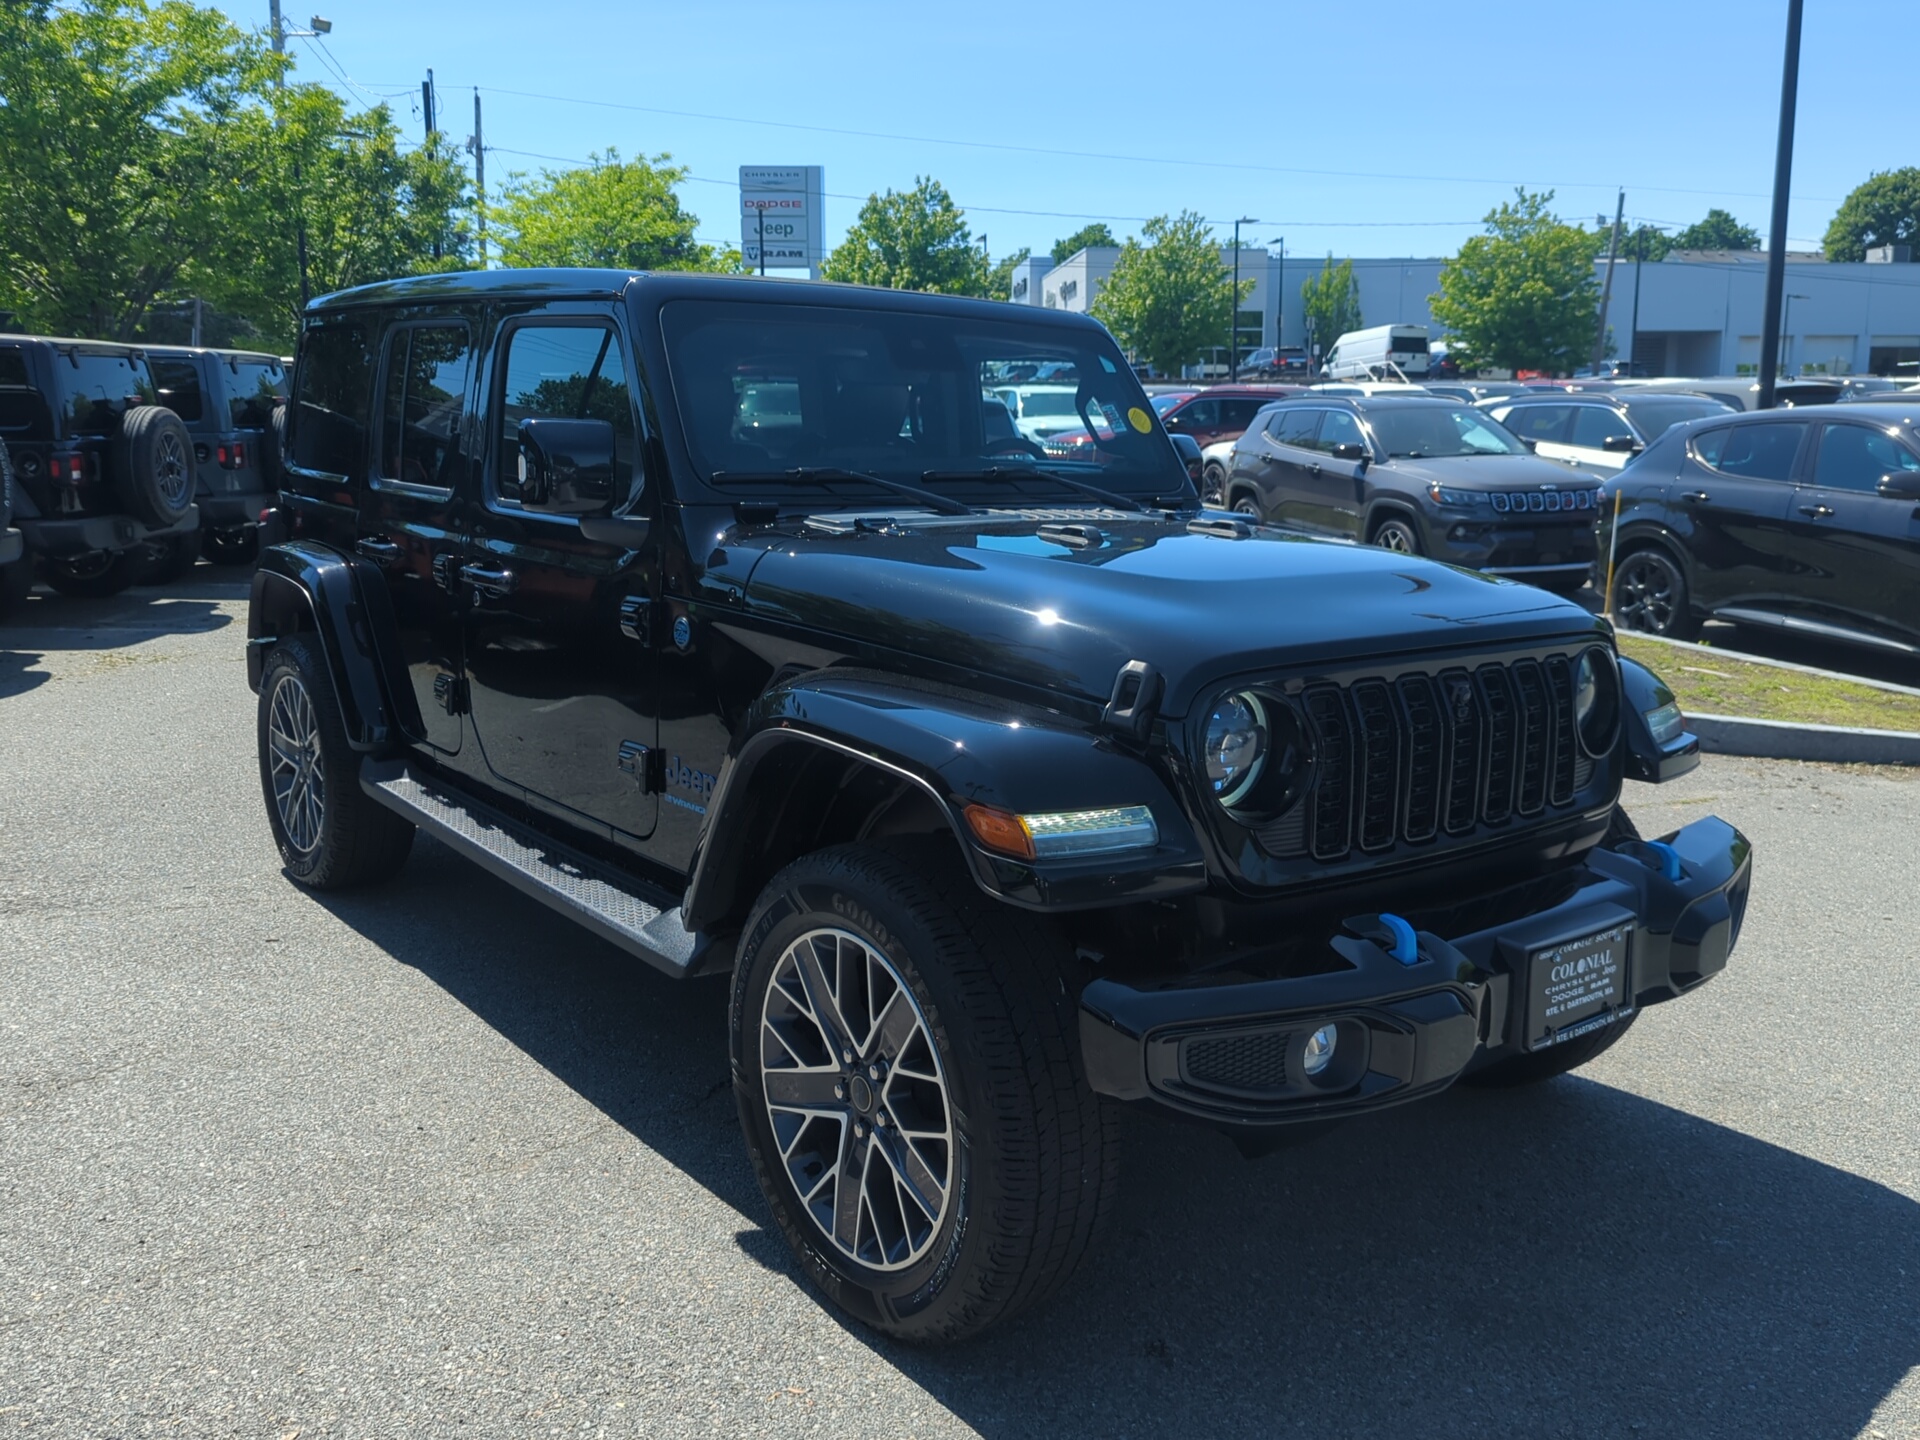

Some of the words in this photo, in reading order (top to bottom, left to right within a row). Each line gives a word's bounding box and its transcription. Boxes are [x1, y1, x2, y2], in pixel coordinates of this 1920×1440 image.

[744, 200, 802, 208] DODGE
[763, 250, 803, 258] RAM
[665, 756, 717, 802] Jeep
[672, 796, 706, 815] WRANG
[1551, 950, 1613, 982] COLONIAL
[1544, 973, 1597, 995] CHRYSLER
[1551, 986, 1585, 1003] DODGE
